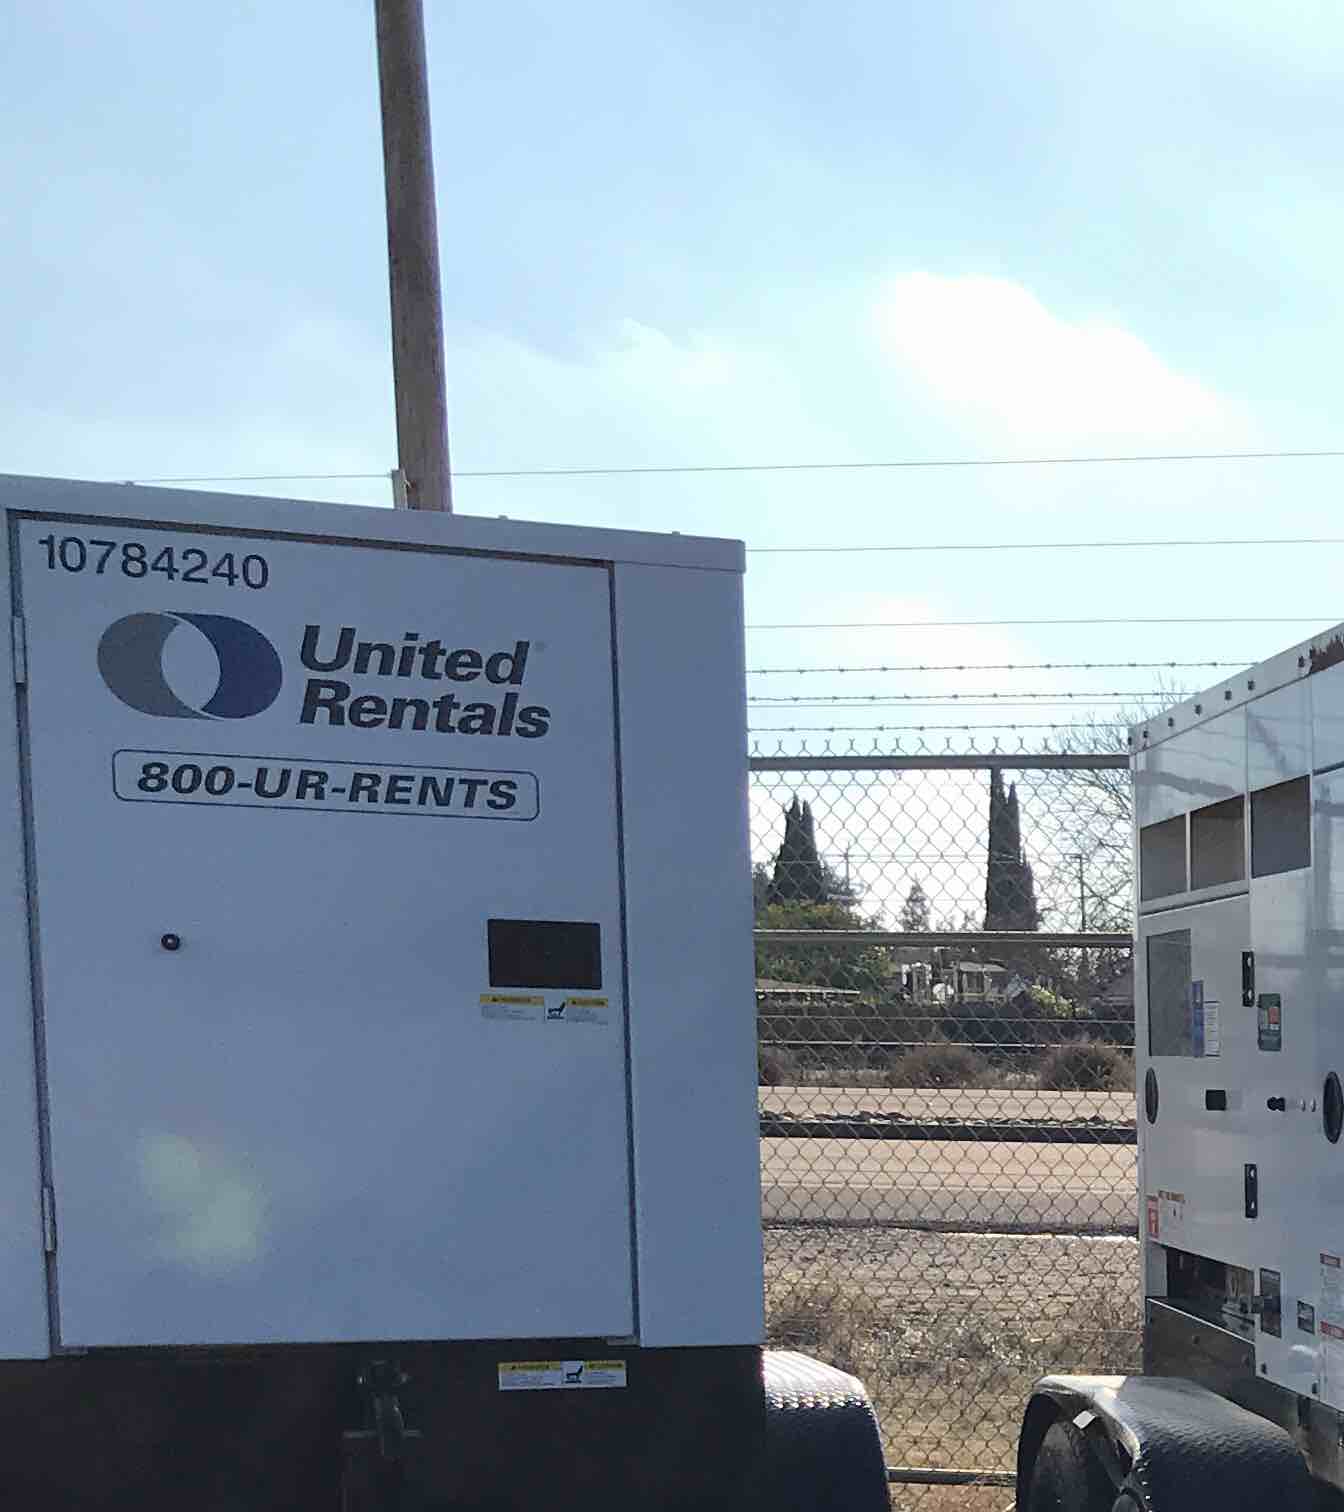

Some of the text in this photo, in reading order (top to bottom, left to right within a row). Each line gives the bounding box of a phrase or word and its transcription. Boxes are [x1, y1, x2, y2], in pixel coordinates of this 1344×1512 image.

[38, 533, 270, 590] 10784240
[300, 624, 531, 686] United
[298, 678, 552, 739] Rentals
[135, 761, 519, 811] 800-UR-RENTS
